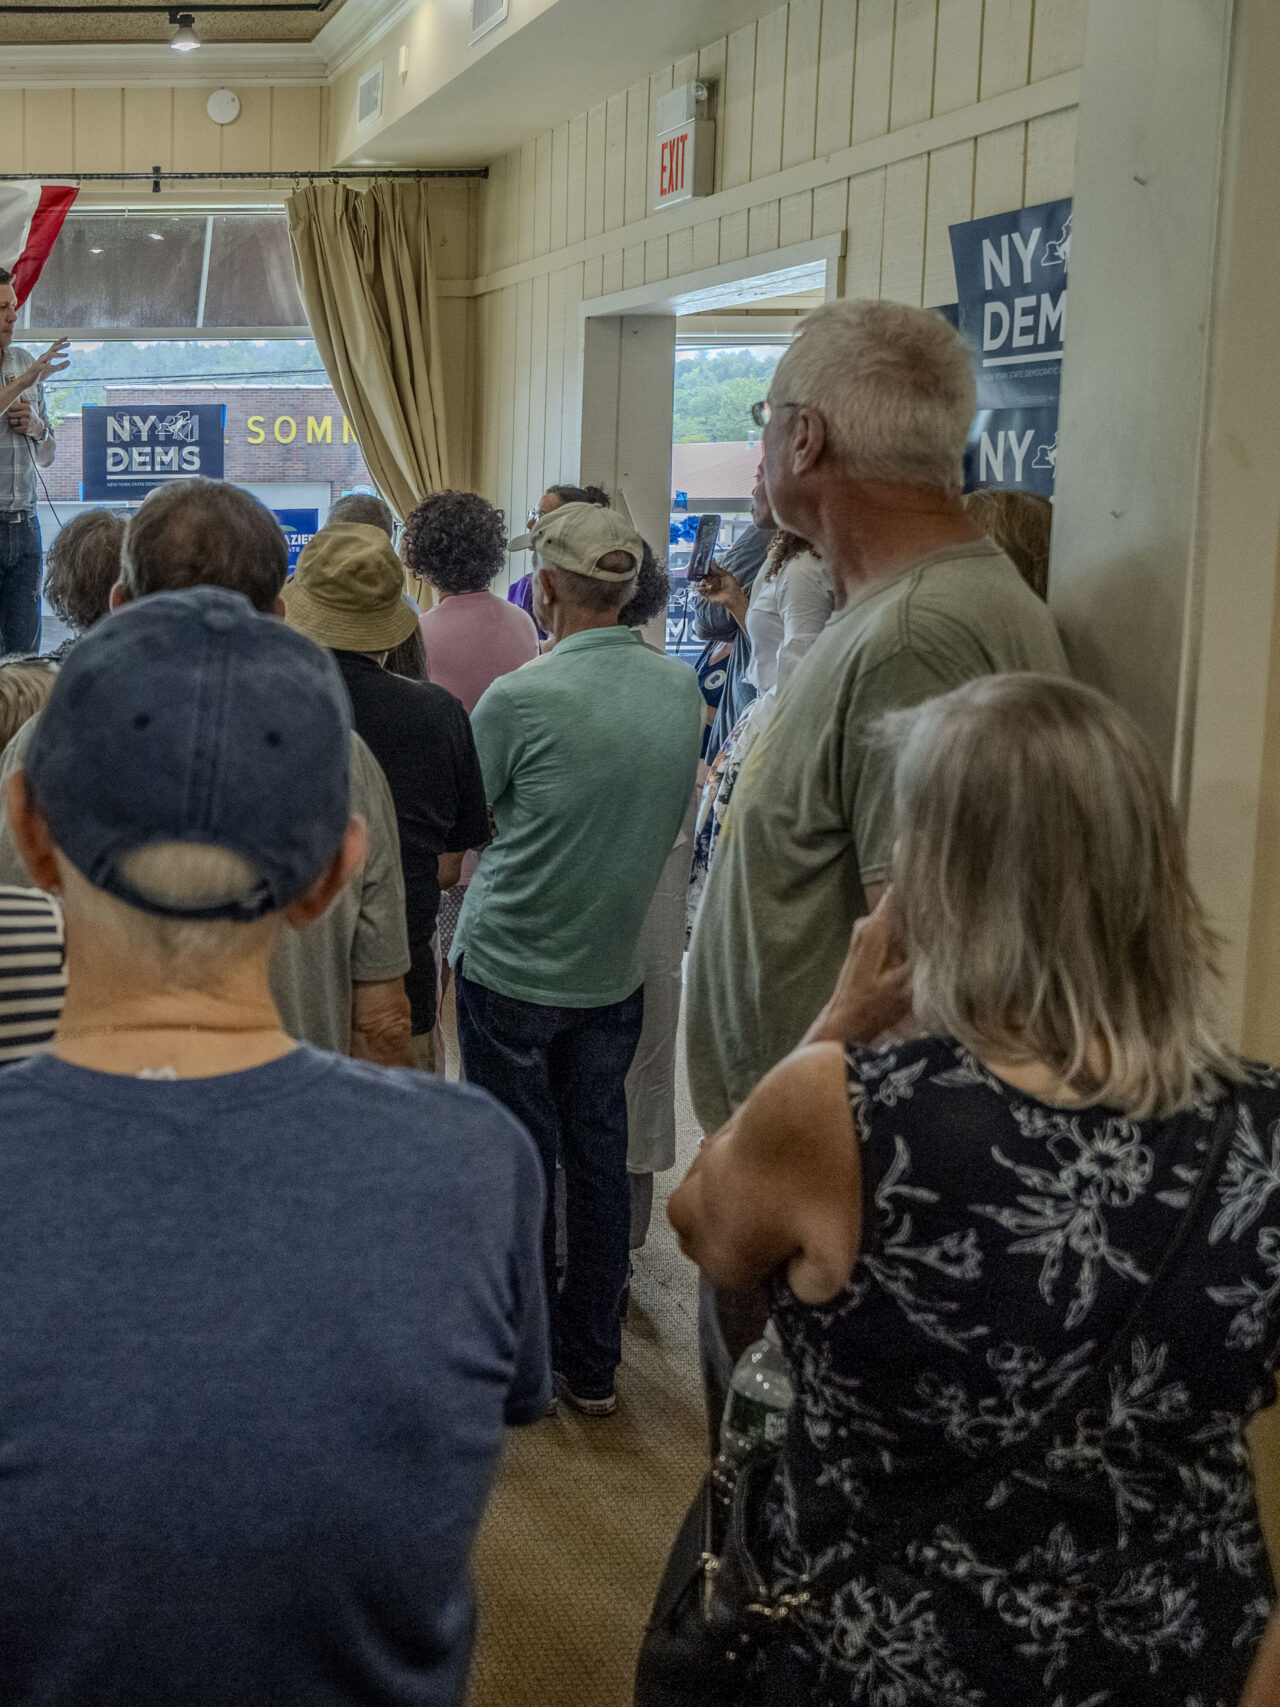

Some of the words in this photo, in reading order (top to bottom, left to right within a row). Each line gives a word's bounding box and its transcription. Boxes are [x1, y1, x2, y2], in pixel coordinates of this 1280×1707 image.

[660, 133, 688, 196] EXIT
[981, 227, 1042, 290] NY
[982, 290, 1067, 352] DEM
[106, 415, 157, 442] NY
[979, 429, 1035, 482] NY
[106, 445, 201, 472] DEMS
